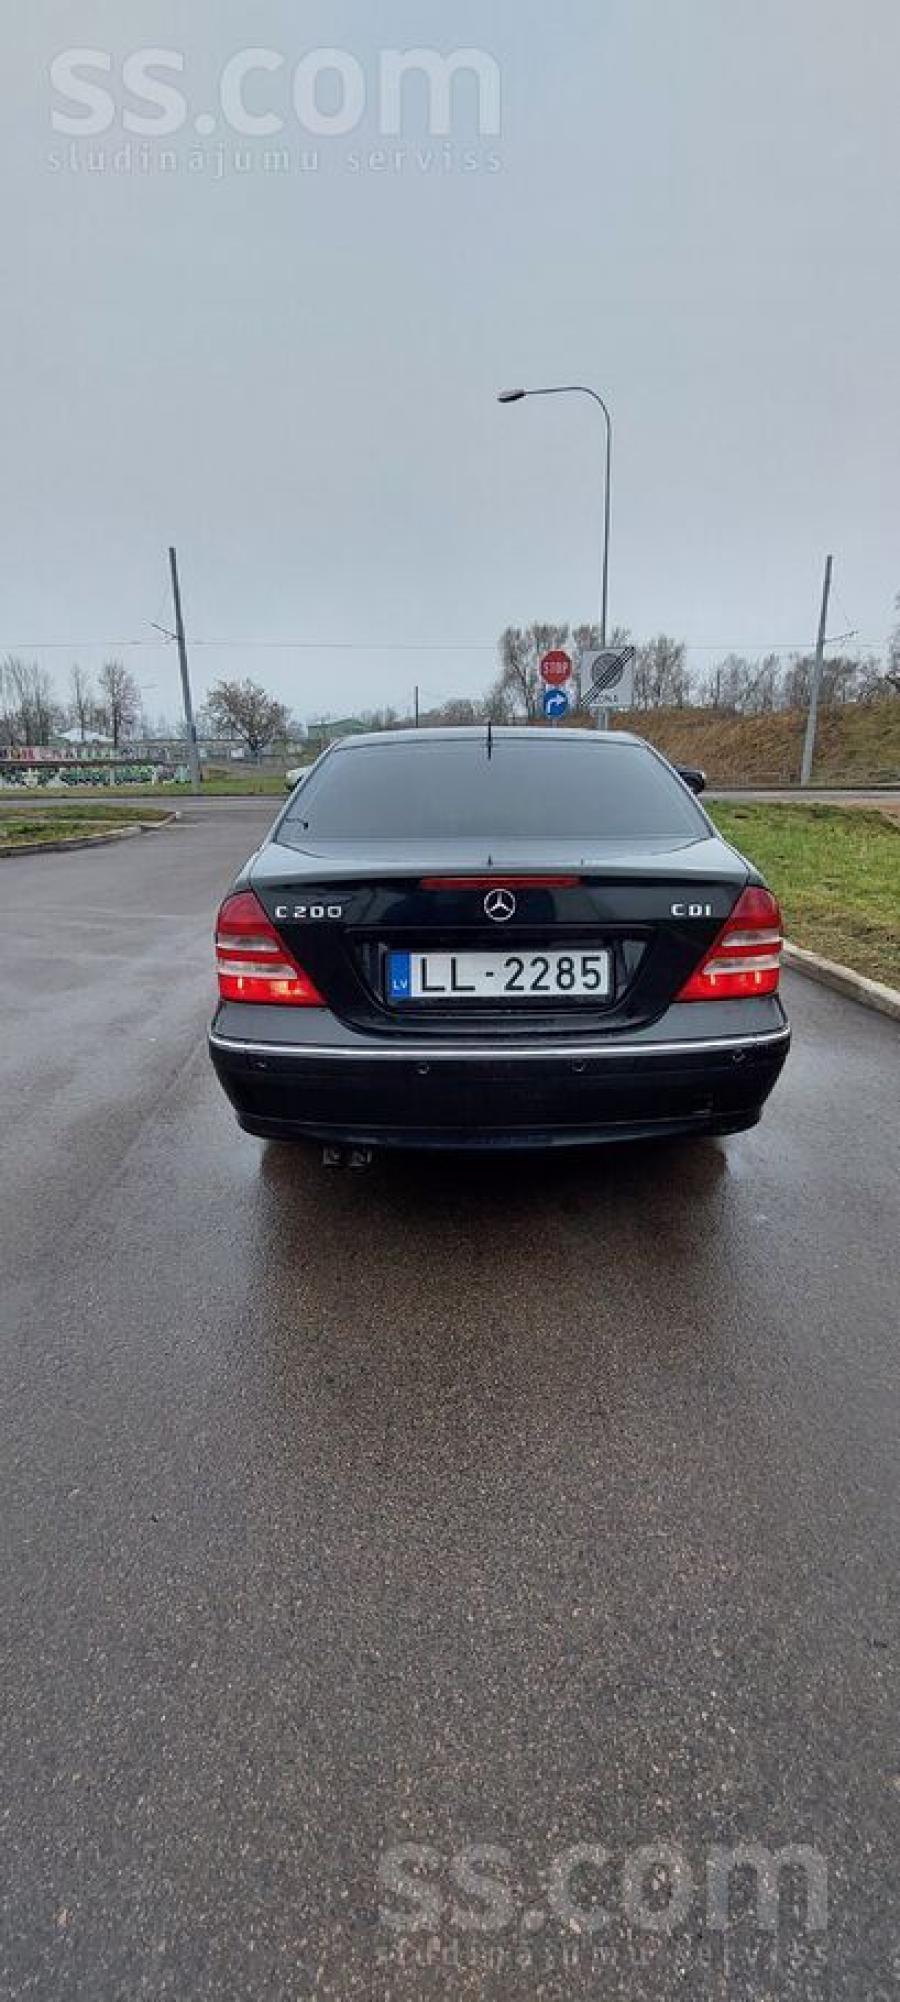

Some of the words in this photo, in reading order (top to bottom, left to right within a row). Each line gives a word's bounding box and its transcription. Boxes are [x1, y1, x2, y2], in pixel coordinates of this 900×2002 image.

[543, 661, 569, 674] STOP
[275, 905, 287, 918] C
[293, 905, 342, 918] 200
[671, 903, 711, 916] CDI
[393, 980, 408, 991] LV
